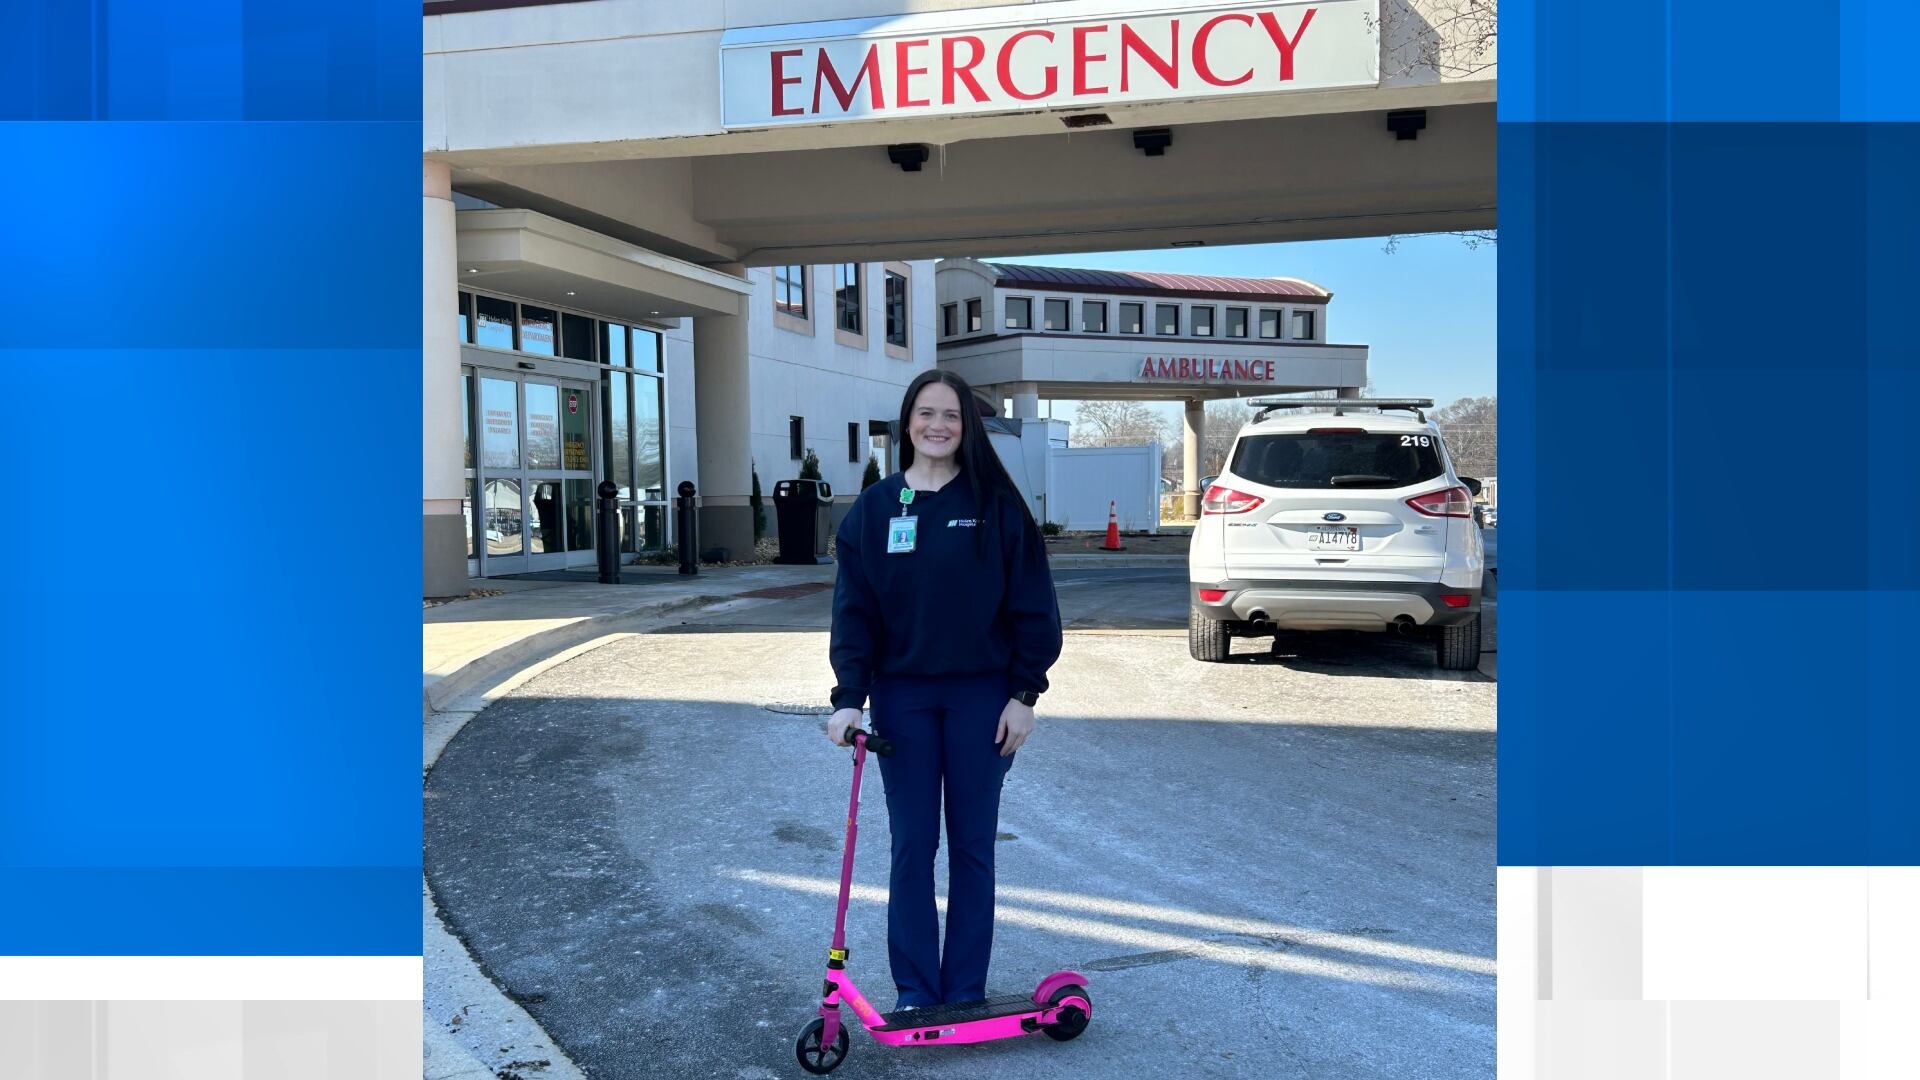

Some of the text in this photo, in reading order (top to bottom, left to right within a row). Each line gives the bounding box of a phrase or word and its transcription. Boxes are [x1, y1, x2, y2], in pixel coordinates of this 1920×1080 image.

[770, 8, 1318, 117] EMERGENCY
[1140, 356, 1275, 381] AMBULANCE
[1400, 435, 1430, 447] 219
[1318, 531, 1357, 545] A147Y8
